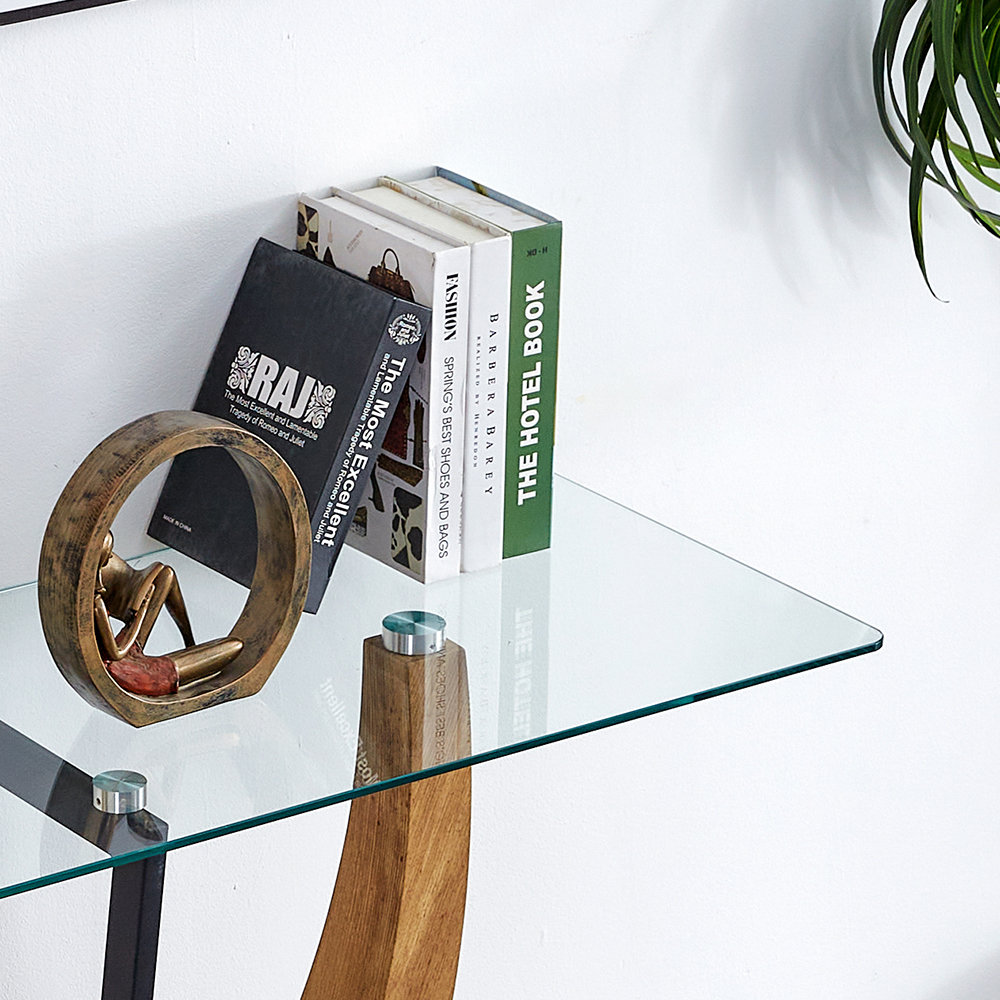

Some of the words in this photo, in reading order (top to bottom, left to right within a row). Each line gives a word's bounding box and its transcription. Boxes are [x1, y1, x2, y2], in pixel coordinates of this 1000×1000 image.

[524, 280, 545, 357] BOOK
[380, 352, 390, 371] and
[381, 357, 406, 394] The
[247, 354, 316, 419] RAJ
[360, 372, 385, 421] Lamentable
[442, 357, 454, 414] SPRING'S
[224, 389, 235, 401] The
[236, 394, 250, 410] Most
[250, 402, 274, 420] Excellent
[274, 414, 286, 426] and
[286, 419, 319, 440] Lamentable
[229, 404, 251, 423] Tragedy
[251, 416, 259, 424] of
[258, 419, 277, 435] Romeo
[278, 429, 289, 440] and
[520, 361, 542, 448] HOTEL
[346, 423, 366, 458] Tragedy
[359, 398, 390, 450] Most
[441, 417, 453, 444] BEST
[342, 459, 350, 469] of
[440, 448, 451, 489] SHOES
[517, 452, 538, 506] THE
[321, 454, 368, 547] Excellent
[330, 469, 348, 500] Romeo
[322, 502, 334, 519] and
[438, 492, 450, 520] AND
[313, 520, 325, 543] Juliet
[438, 524, 449, 559] BAGS
